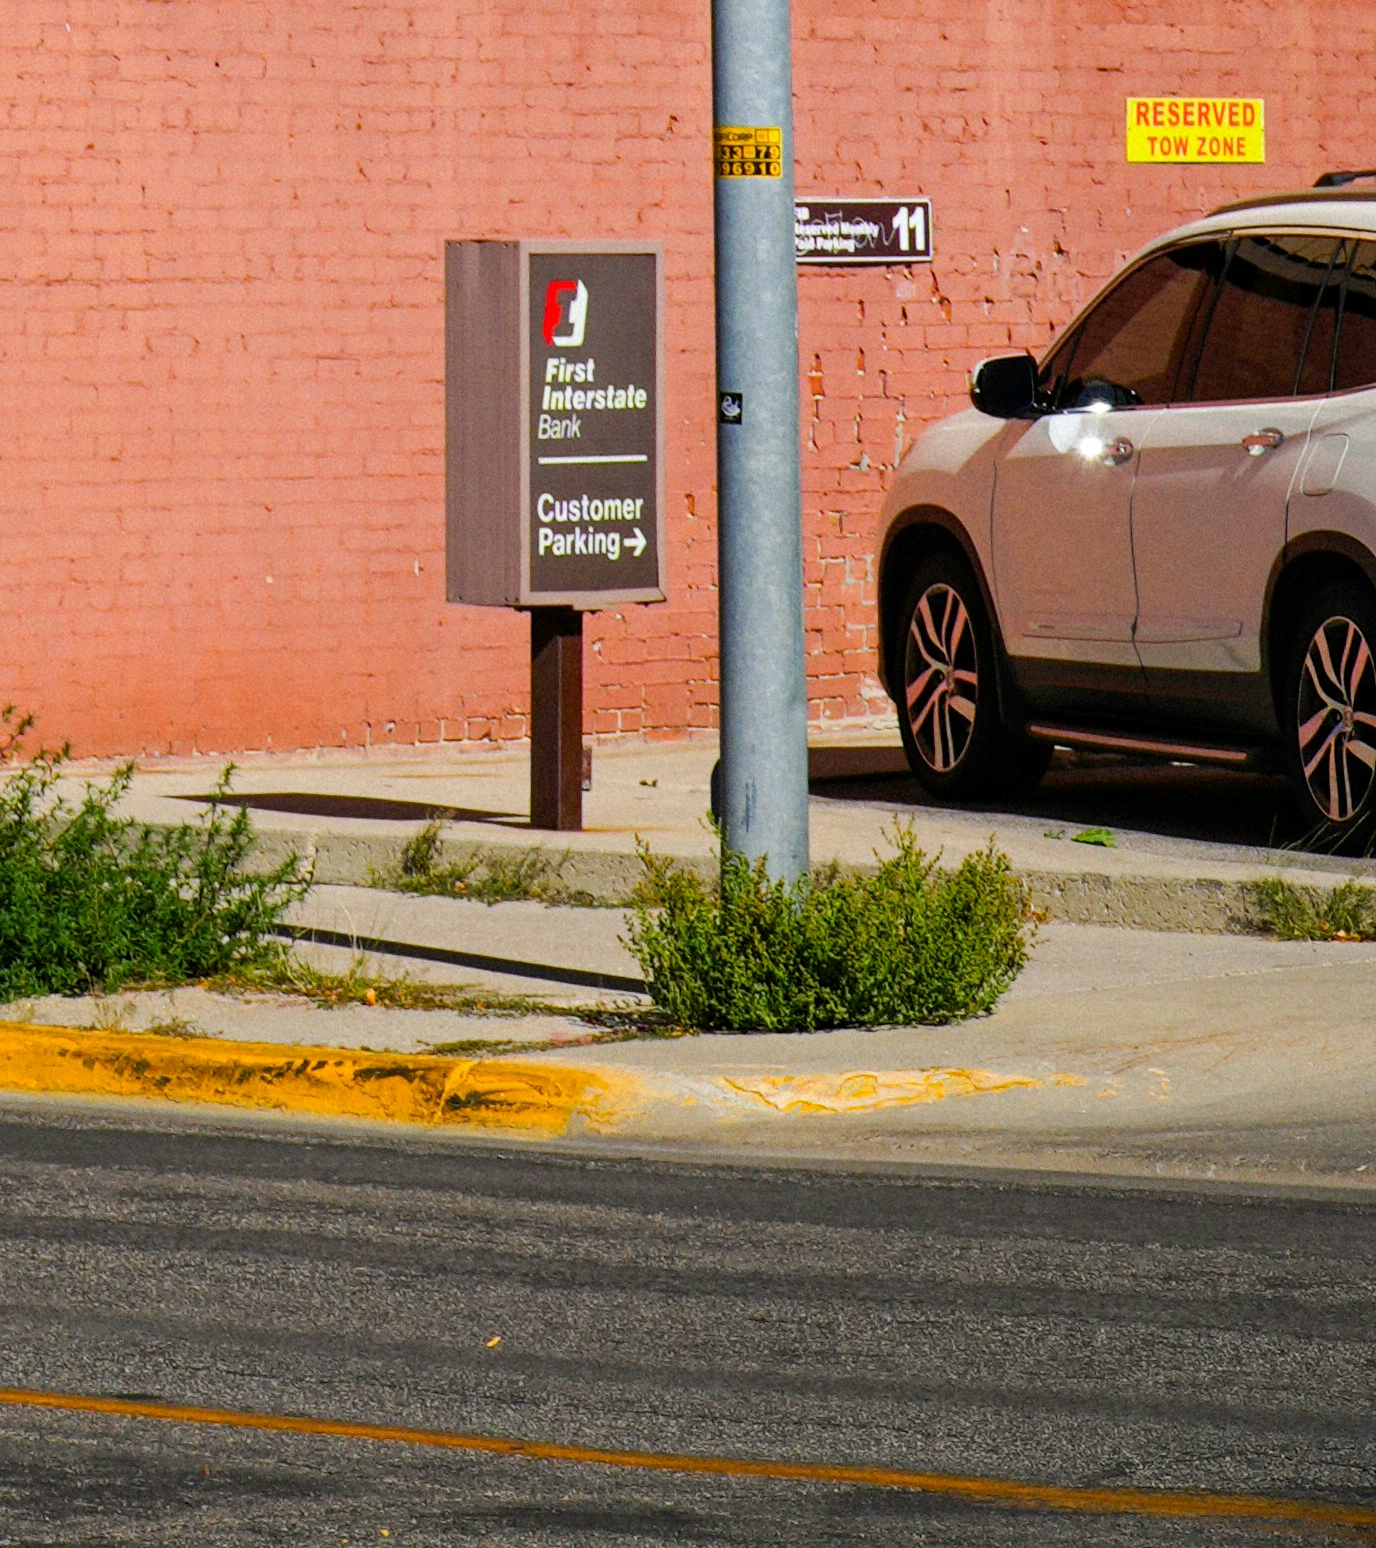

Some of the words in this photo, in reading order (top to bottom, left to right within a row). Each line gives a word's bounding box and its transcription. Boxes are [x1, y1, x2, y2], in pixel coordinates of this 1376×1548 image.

[1136, 102, 1255, 126] RESERVED
[1147, 137, 1188, 156] TOW
[1197, 137, 1246, 156] ZONE
[892, 206, 925, 251] 11
[545, 357, 595, 383] First
[542, 384, 647, 411] Interstate
[537, 413, 582, 439] Bank
[537, 493, 644, 523] Customer
[538, 526, 621, 561] Parking
